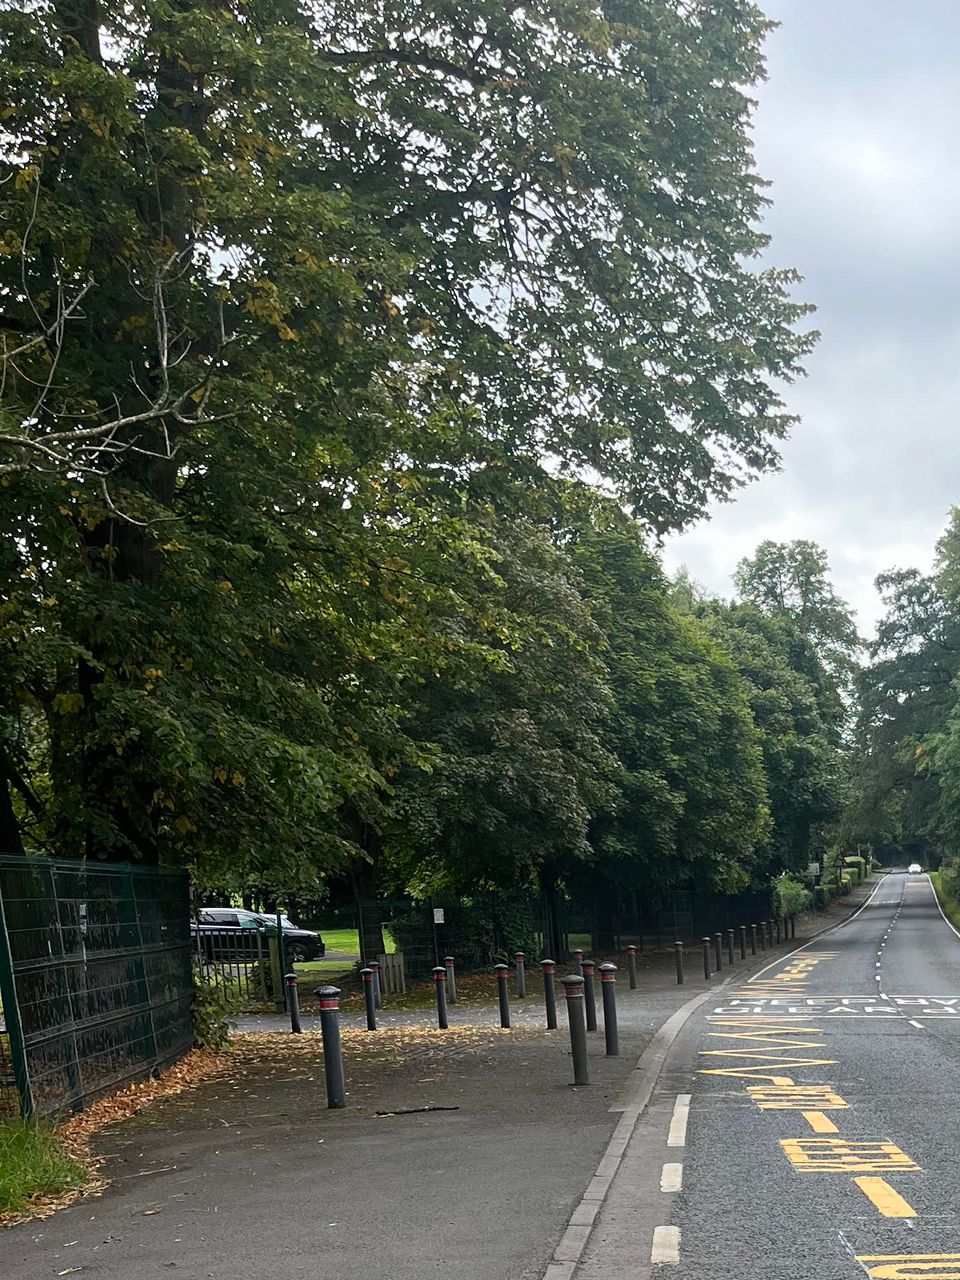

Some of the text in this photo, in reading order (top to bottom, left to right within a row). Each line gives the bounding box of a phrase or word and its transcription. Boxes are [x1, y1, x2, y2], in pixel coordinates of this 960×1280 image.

[728, 998, 877, 1006] KEEP
[713, 1006, 902, 1014] CLEAR
[780, 1138, 923, 1173] KEEP
